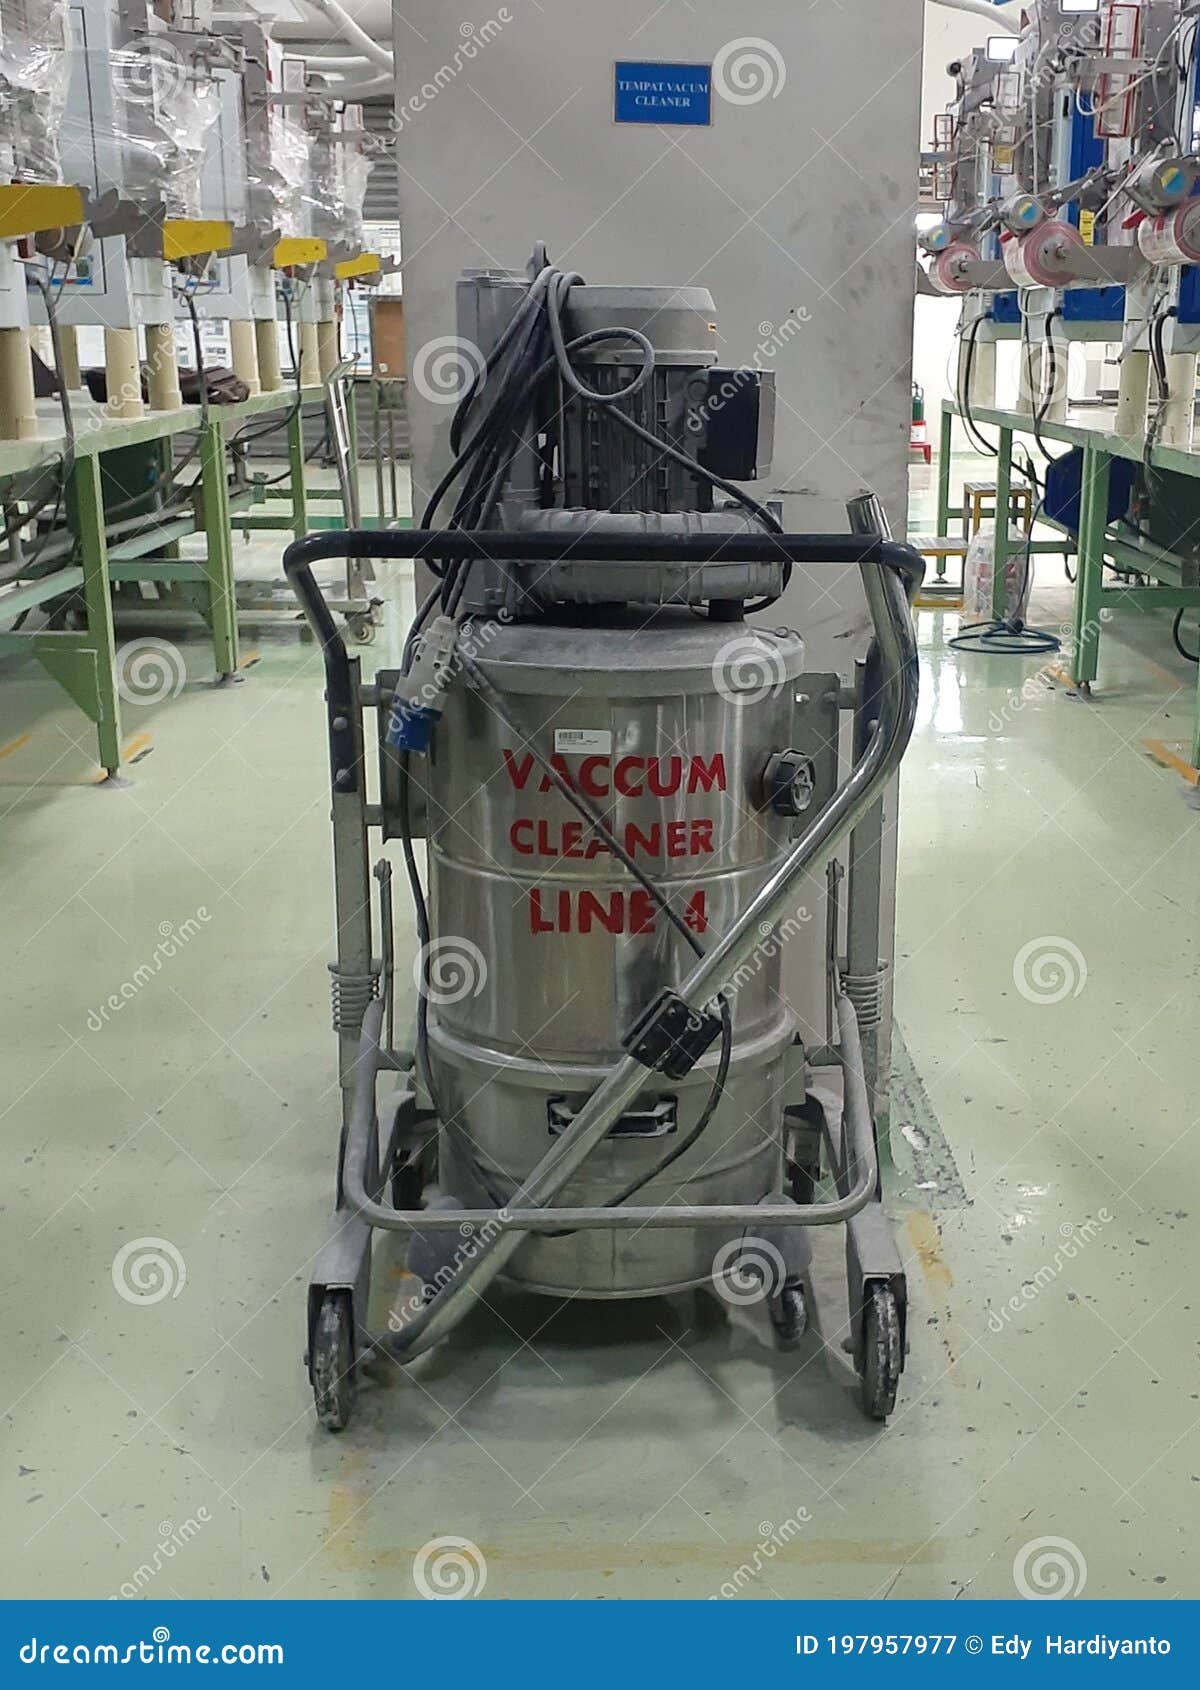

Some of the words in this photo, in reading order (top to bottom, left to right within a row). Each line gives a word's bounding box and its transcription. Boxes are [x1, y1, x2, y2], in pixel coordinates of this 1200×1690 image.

[618, 80, 664, 92] TEMPAT
[666, 82, 709, 94] VACUM
[634, 95, 691, 107] CLEANER
[502, 749, 727, 797] VACCUM
[509, 819, 715, 860] CLEANER
[529, 887, 656, 935] LINE
[683, 890, 709, 933] 4
